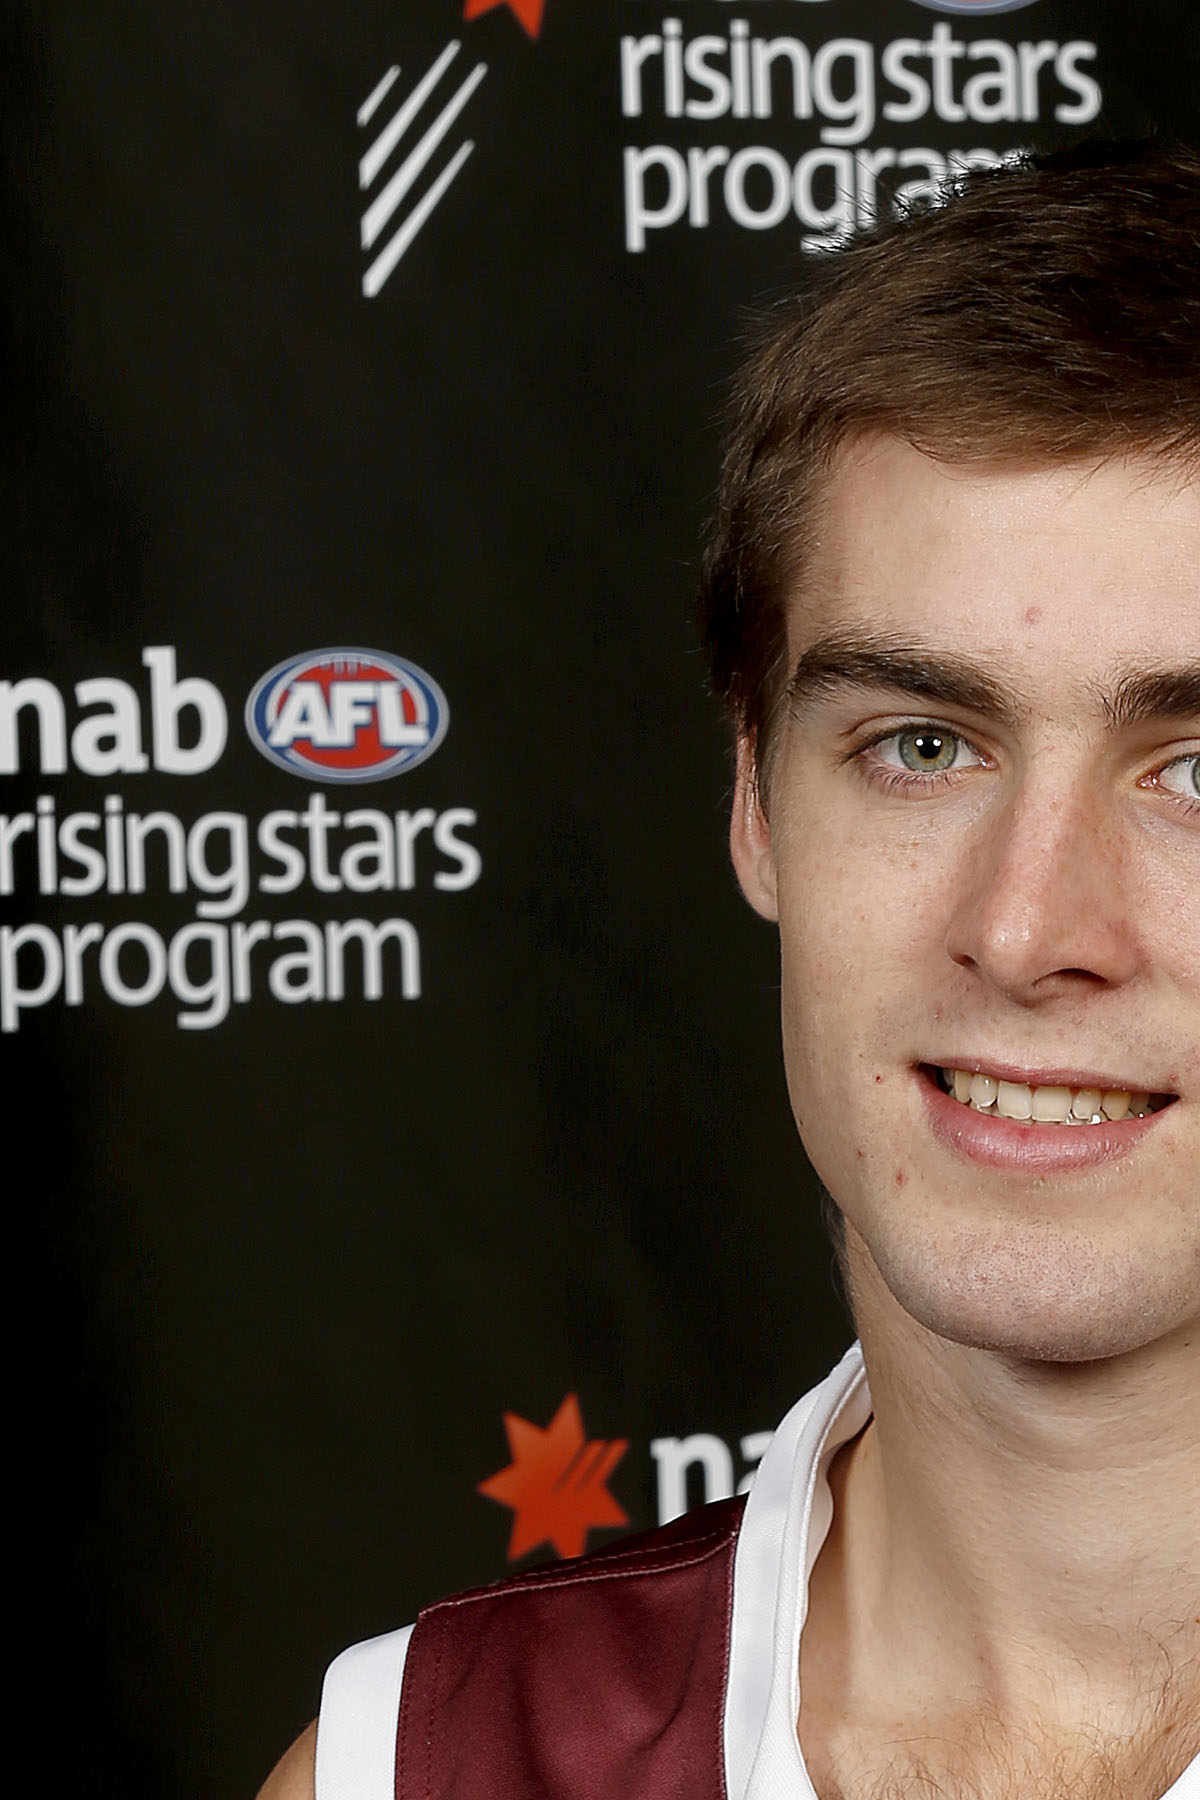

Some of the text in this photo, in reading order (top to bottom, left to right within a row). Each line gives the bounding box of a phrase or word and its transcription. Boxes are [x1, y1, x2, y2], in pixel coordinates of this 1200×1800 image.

[622, 145, 1034, 254] progra
[0, 645, 229, 776] nab
[267, 680, 430, 749] AFL
[0, 917, 422, 1033] program
